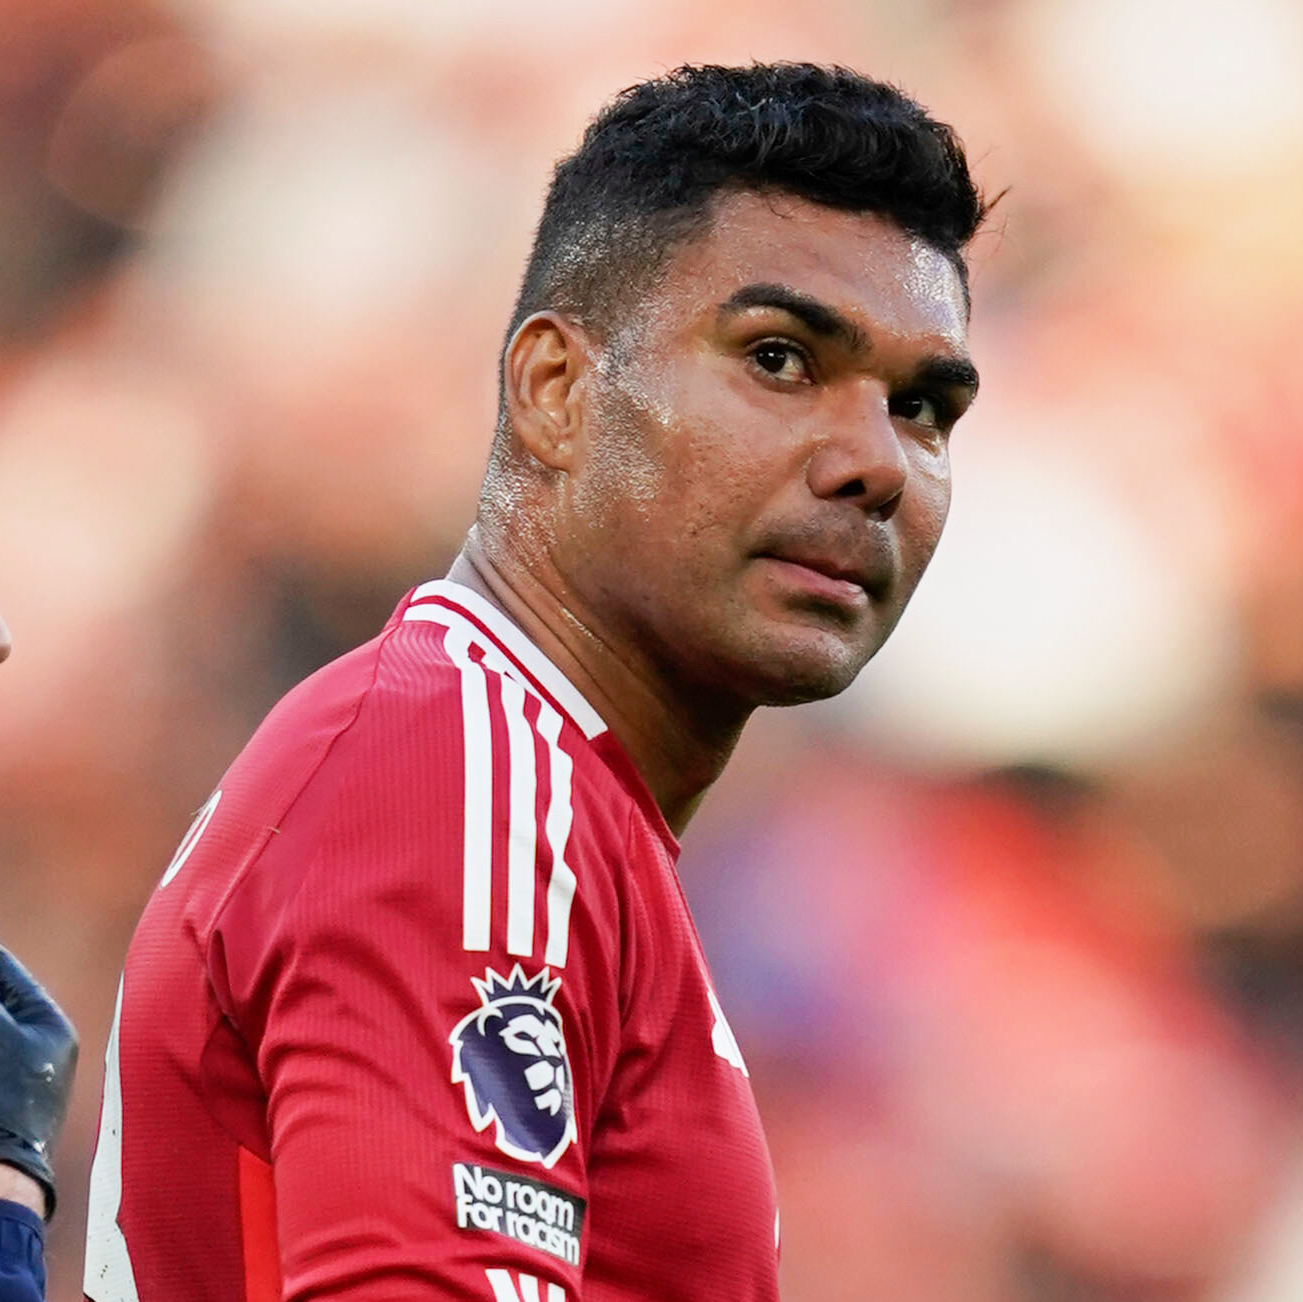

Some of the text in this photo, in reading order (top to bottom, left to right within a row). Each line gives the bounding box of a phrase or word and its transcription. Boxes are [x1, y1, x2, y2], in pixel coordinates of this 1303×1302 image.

[453, 1162, 574, 1231] No room
[505, 1210, 580, 1266] racism
